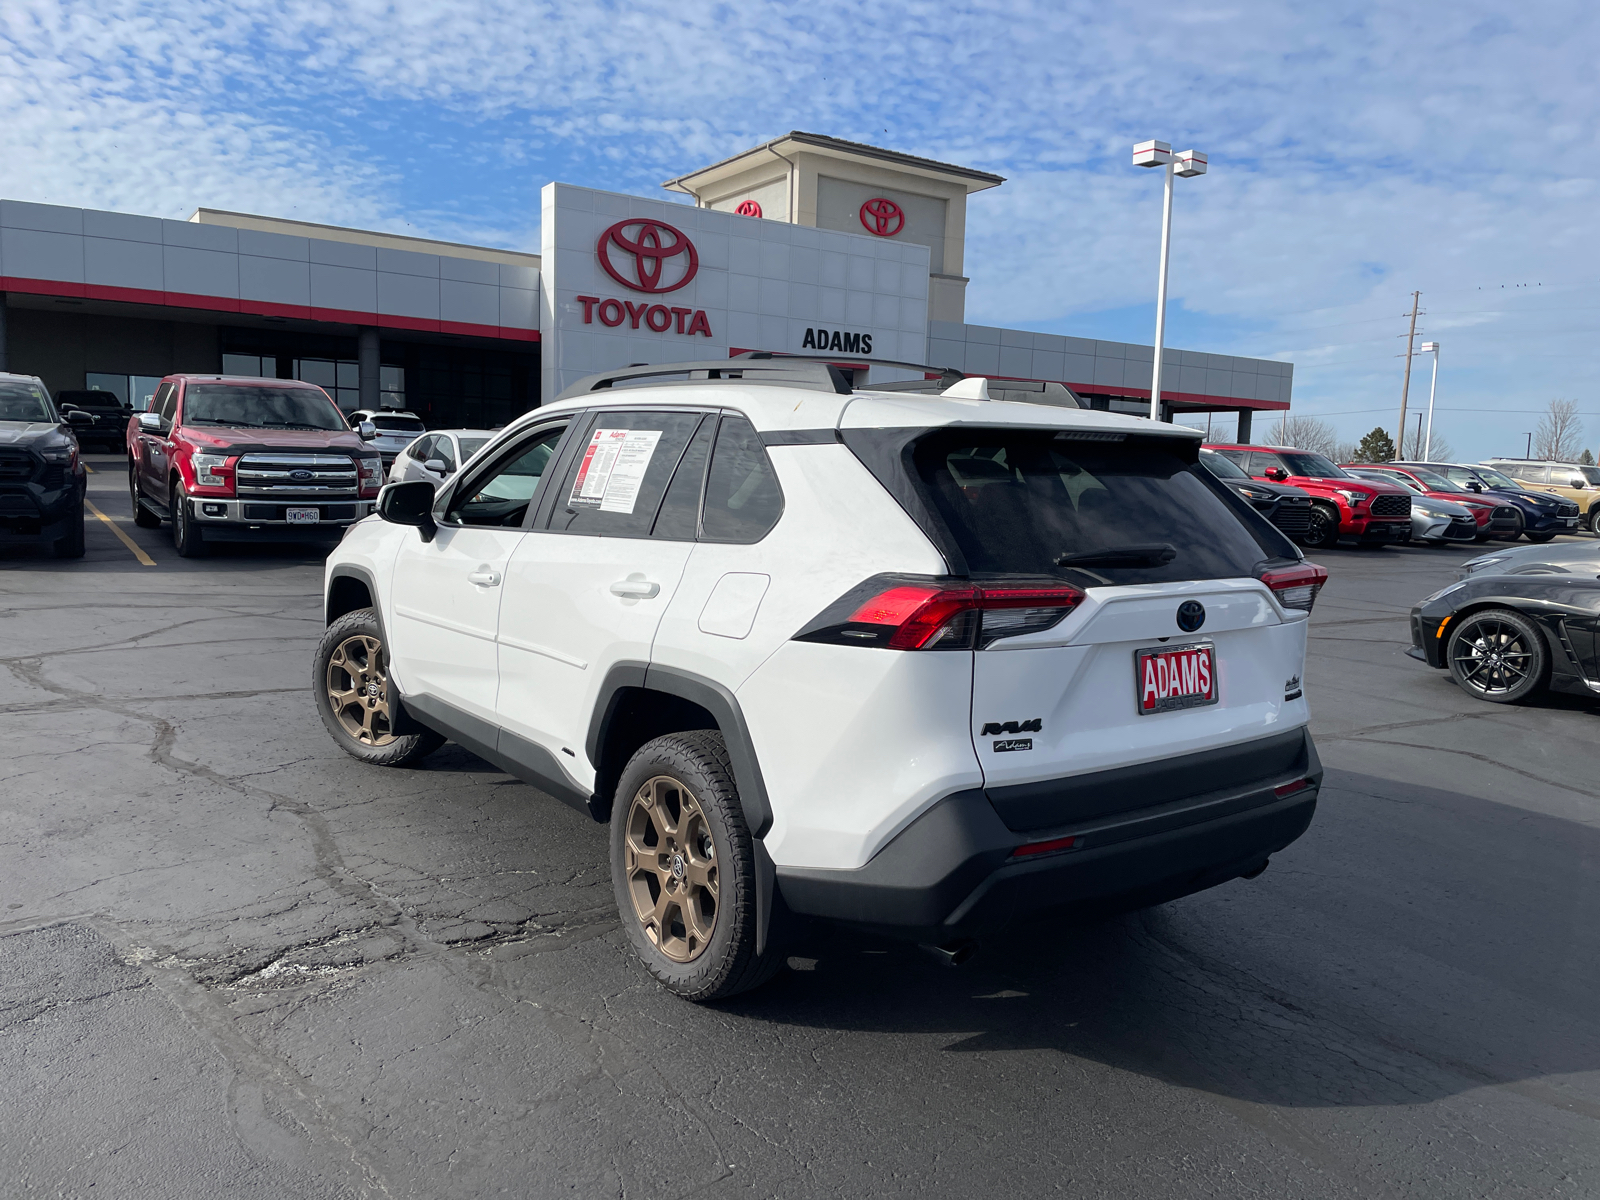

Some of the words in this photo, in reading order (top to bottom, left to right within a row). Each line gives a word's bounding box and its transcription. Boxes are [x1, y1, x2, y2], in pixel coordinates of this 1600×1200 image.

[577, 295, 712, 337] TOYOTA
[802, 328, 872, 354] ADAMS
[1143, 653, 1210, 701] ADAMS
[981, 718, 1042, 736] RAV4
